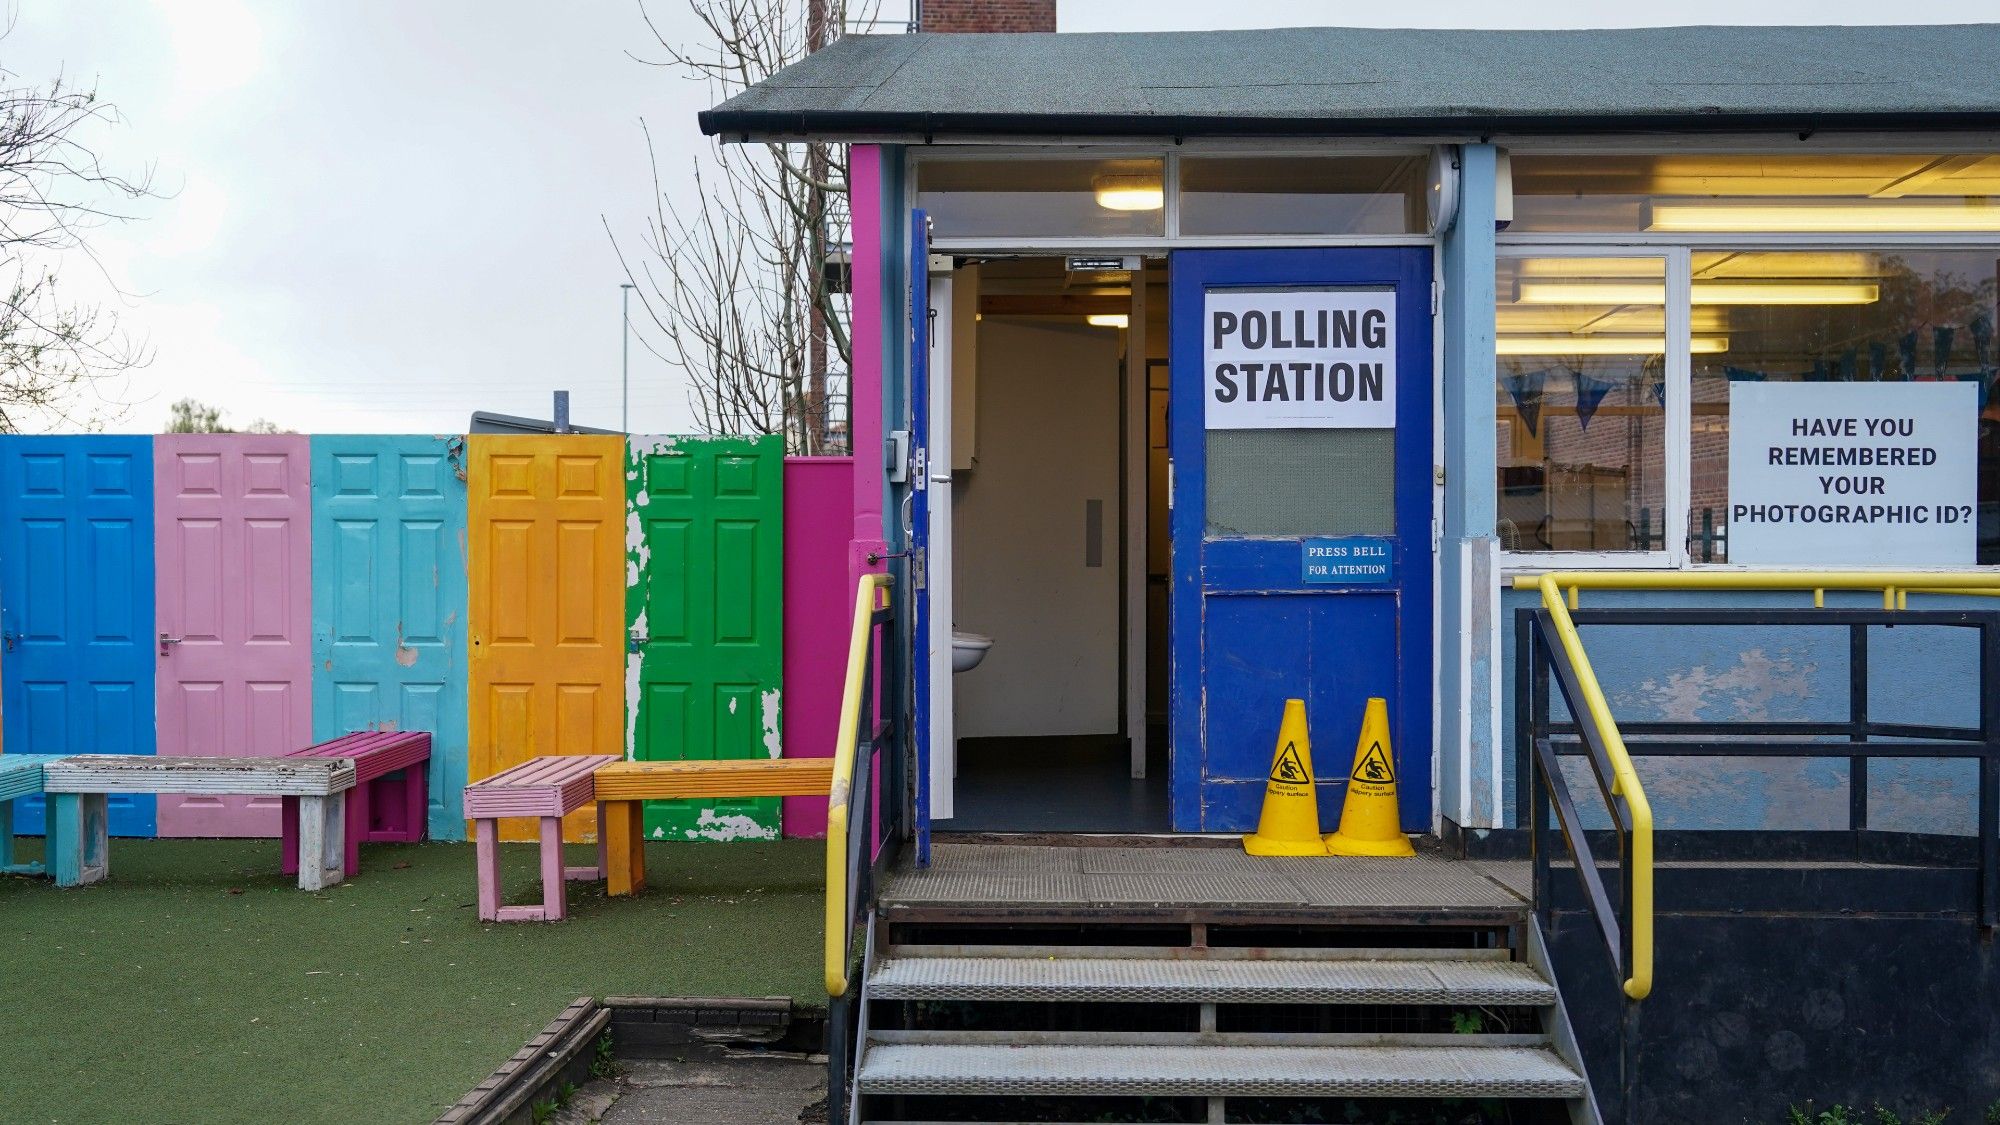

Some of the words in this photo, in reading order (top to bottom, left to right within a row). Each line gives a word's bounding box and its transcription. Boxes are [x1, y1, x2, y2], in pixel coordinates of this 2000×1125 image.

[1213, 308, 1386, 350] POLLING
[1214, 362, 1383, 404] STATION
[1792, 418, 1858, 437] HAVE
[1864, 418, 1914, 437] YOU
[1768, 446, 1937, 466] REMEMBERED
[1818, 476, 1885, 495] YOUR
[1733, 504, 1929, 524] PHOTOGRAPHIC
[1936, 505, 1973, 524] ID?
[1308, 547, 1348, 557] PRESS
[1353, 546, 1386, 557] BELL
[1308, 565, 1328, 575] FOR
[1331, 564, 1386, 575] ATTENTION
[1275, 783, 1298, 791] Caution
[1360, 783, 1385, 791] Caution
